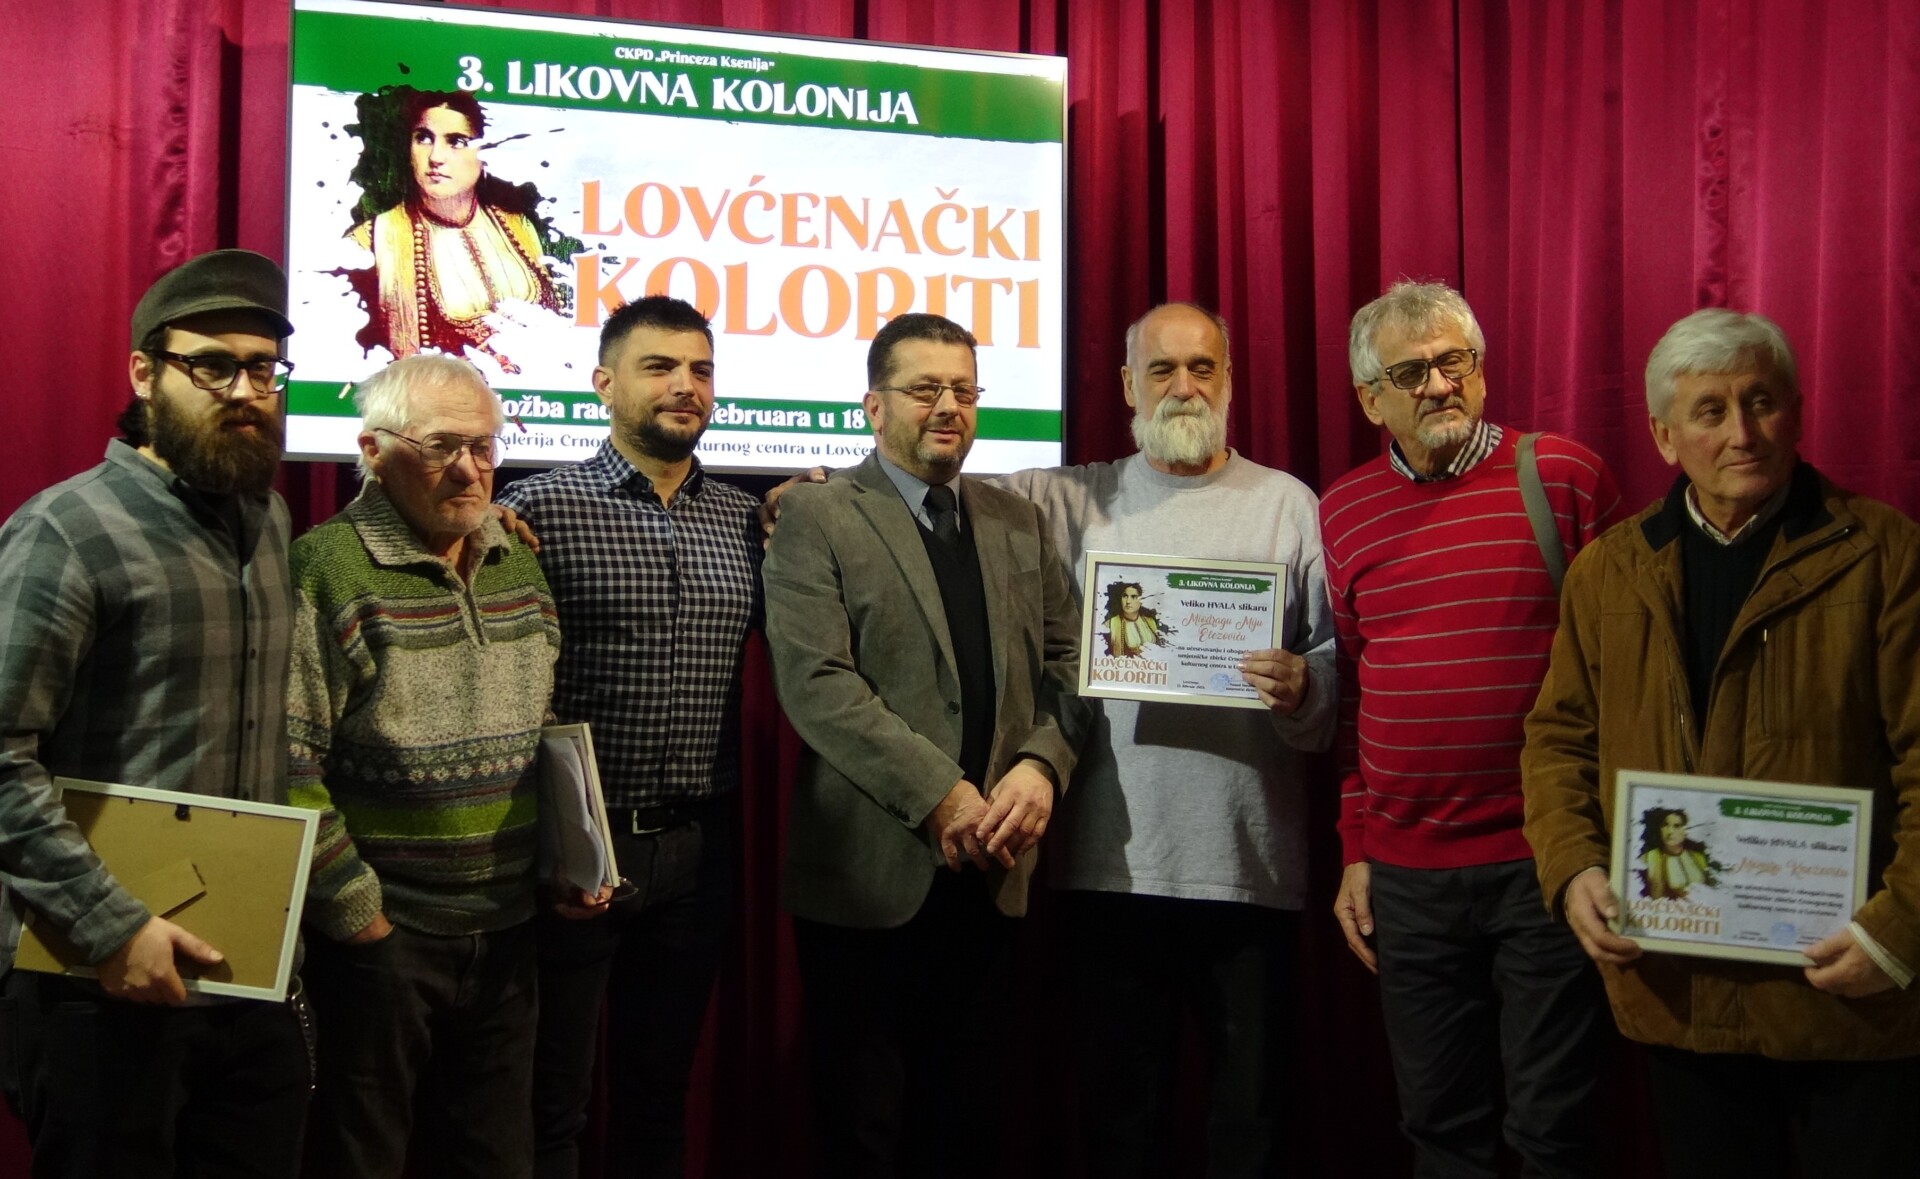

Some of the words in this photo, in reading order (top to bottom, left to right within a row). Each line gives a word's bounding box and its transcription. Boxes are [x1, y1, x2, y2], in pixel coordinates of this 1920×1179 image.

[615, 46, 653, 61] CKPD
[457, 56, 494, 92] 3.
[507, 60, 699, 108] LIKOVNA
[712, 77, 919, 124] KOLONIJA
[581, 175, 1041, 262] LOVĆENAČKI
[573, 253, 1040, 349] KOLORITI
[818, 411, 835, 428] u
[842, 408, 866, 429] 18
[502, 432, 554, 448] alerija
[560, 434, 605, 448] Crno
[756, 442, 805, 455] centra
[811, 446, 820, 455] u
[1186, 579, 1218, 589] LIKOVNA
[1220, 582, 1256, 591] KOLONIJA
[1180, 599, 1205, 609] Veliko
[1207, 601, 1236, 610] HVALA
[1238, 602, 1268, 612] slikaru
[1092, 669, 1167, 685] KOLORITI
